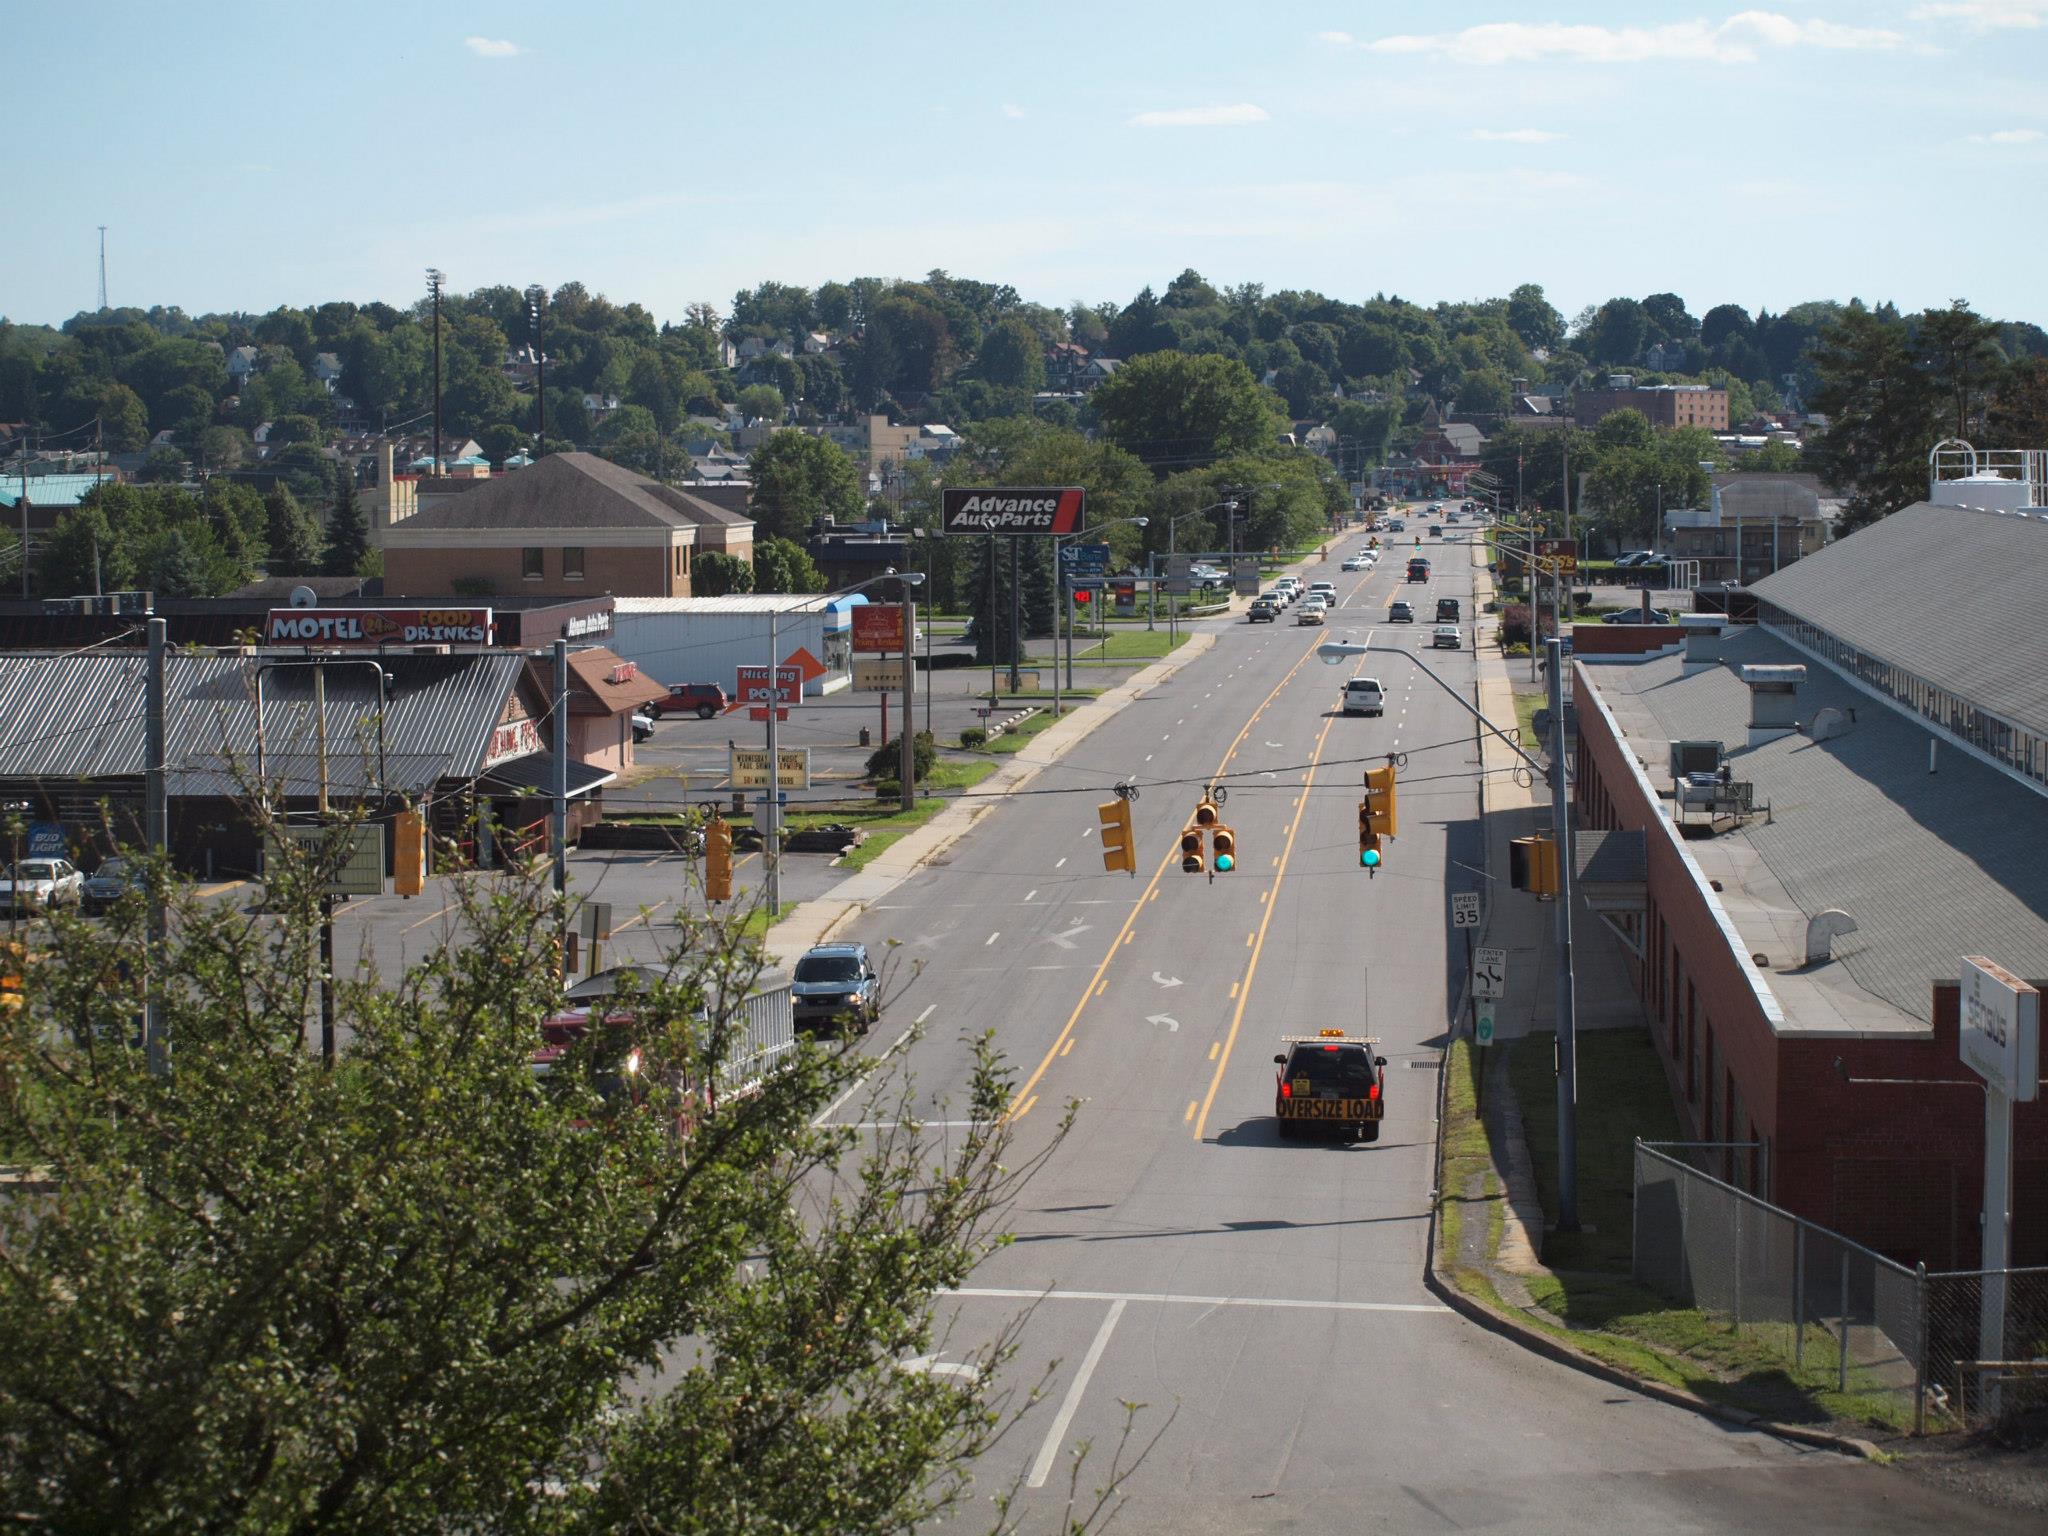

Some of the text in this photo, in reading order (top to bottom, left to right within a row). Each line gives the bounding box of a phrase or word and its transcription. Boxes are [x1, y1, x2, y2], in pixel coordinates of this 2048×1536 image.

[960, 496, 1057, 512] Advance
[1062, 546, 1082, 561] S&T
[419, 610, 473, 625] FOOD
[271, 617, 363, 639] MOTEL
[404, 625, 485, 641] DRINKS
[742, 669, 796, 682] Hitcing
[737, 754, 768, 762] WEDNESDAY
[35, 833, 60, 842] BUD
[30, 843, 64, 852] LIGHT
[1455, 910, 1478, 924] 35
[1478, 949, 1504, 957] CENTER
[1276, 1099, 1384, 1118] OVERSIZE LOAD
